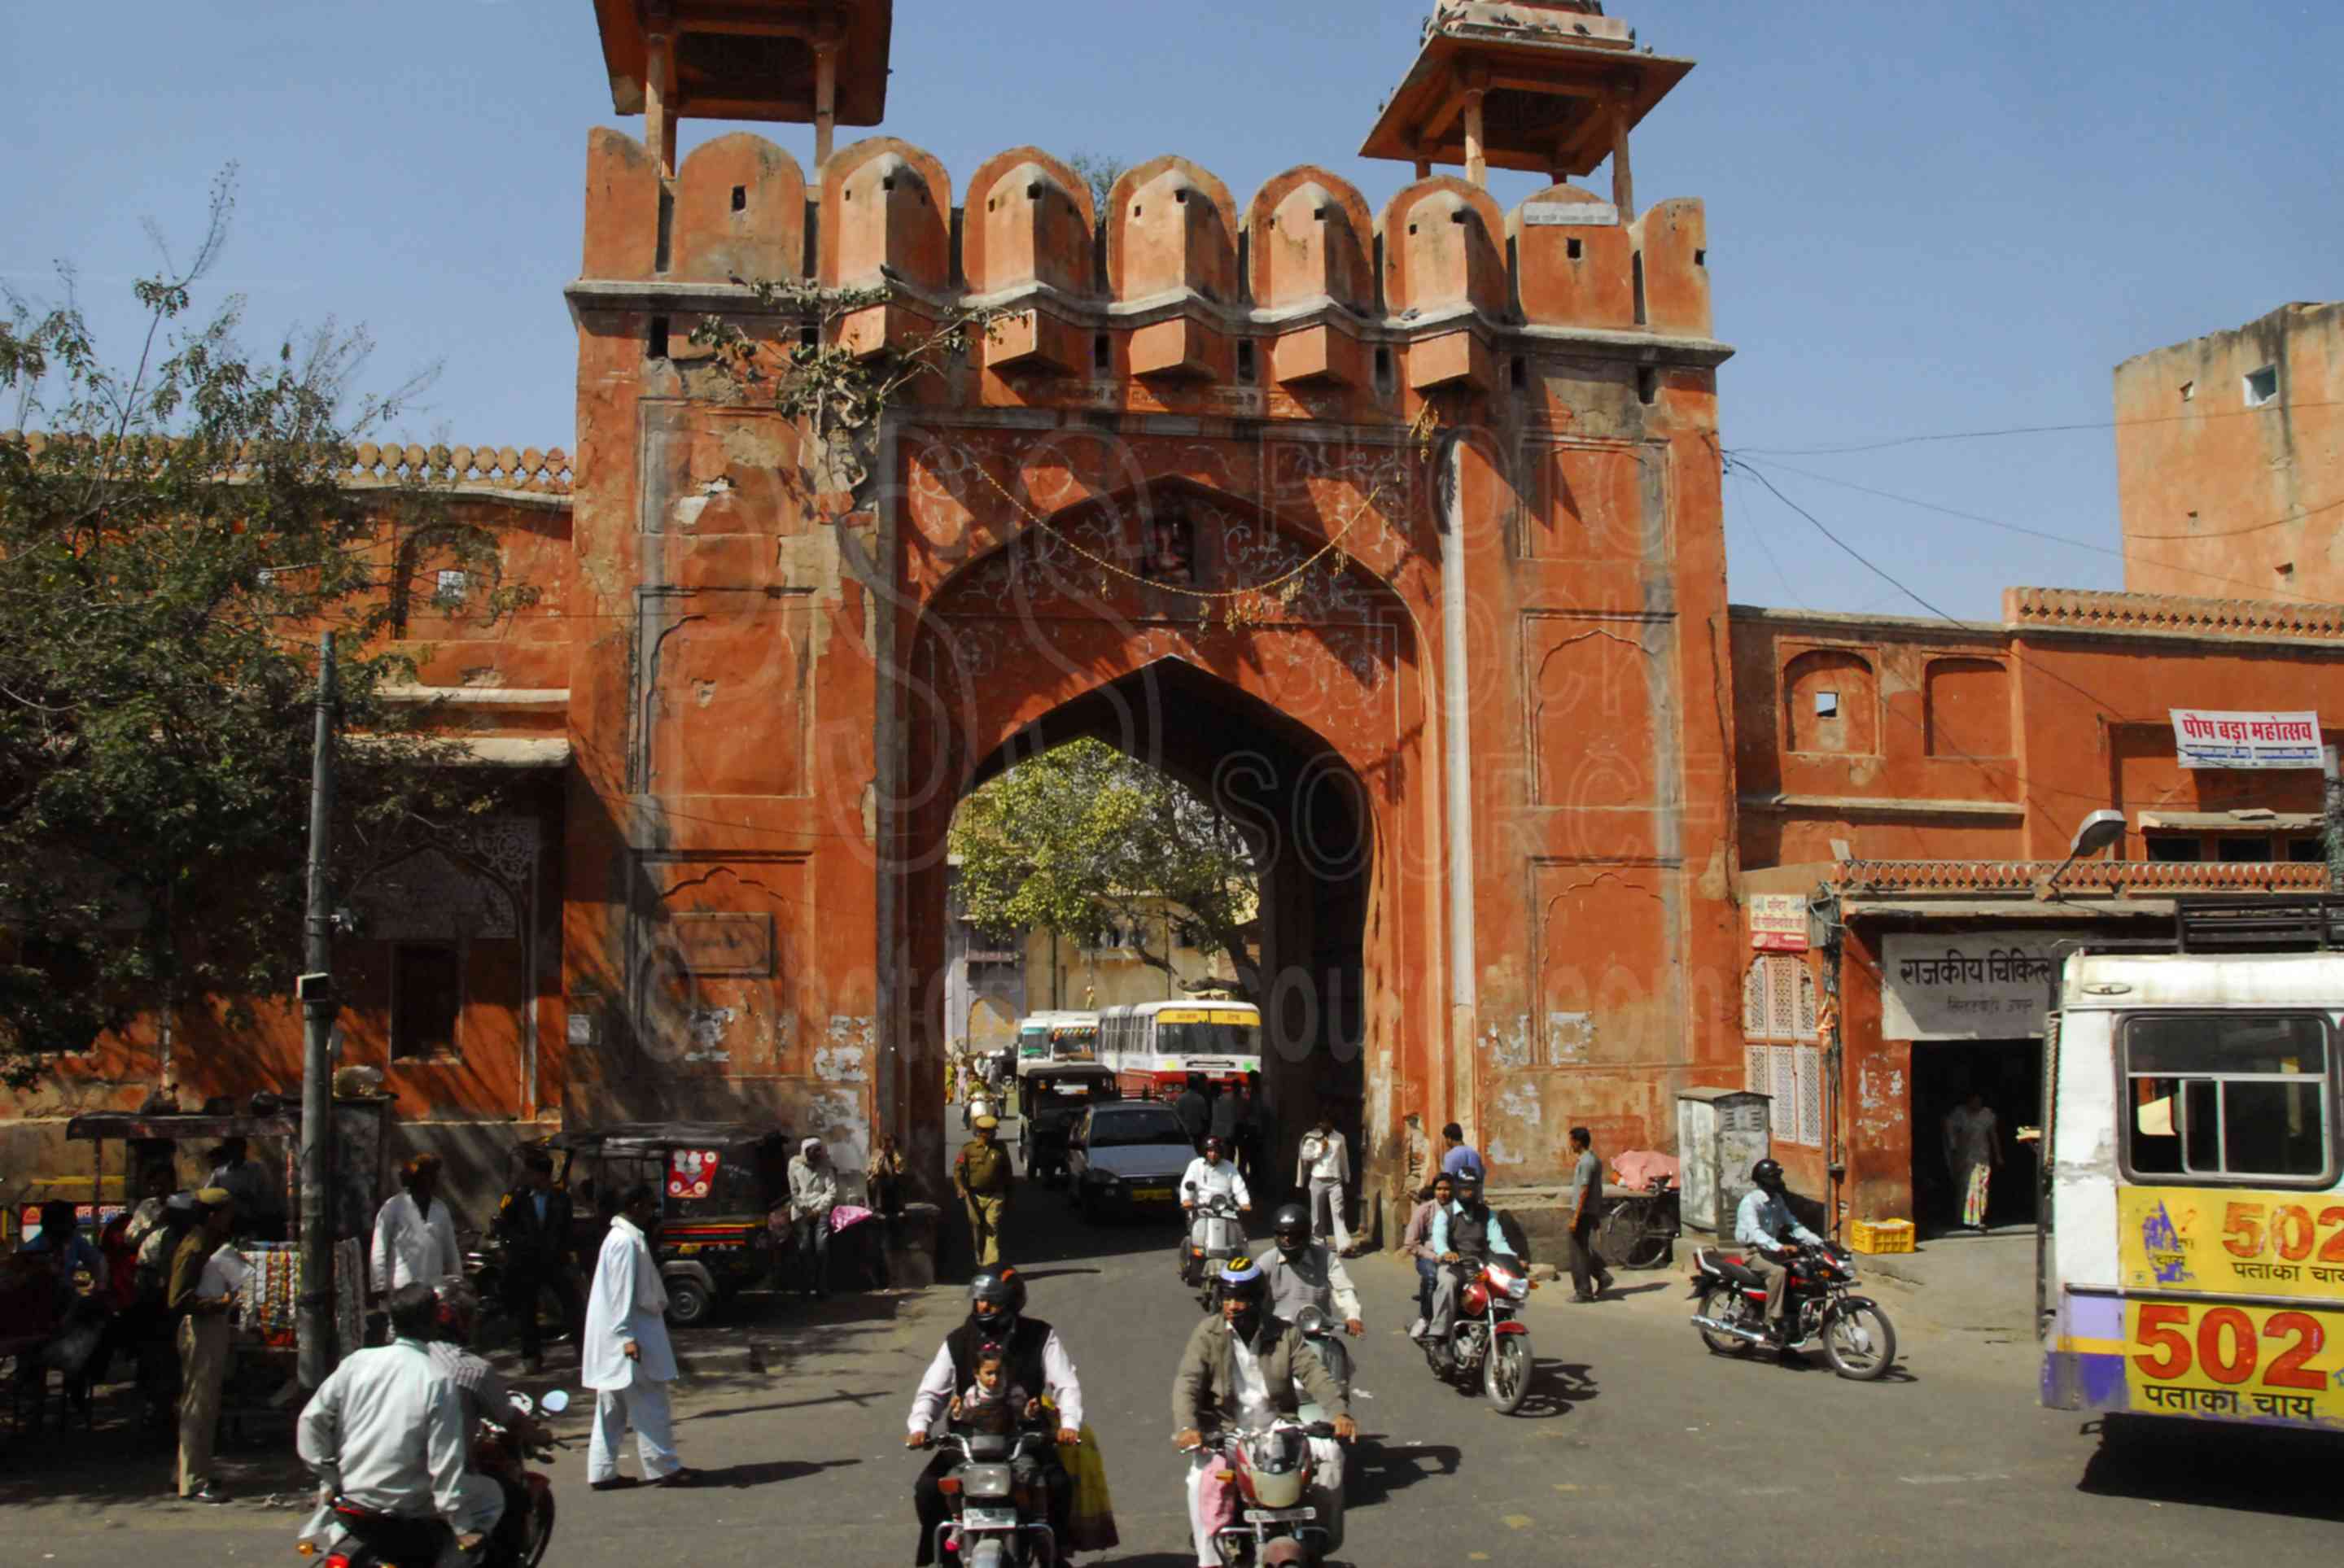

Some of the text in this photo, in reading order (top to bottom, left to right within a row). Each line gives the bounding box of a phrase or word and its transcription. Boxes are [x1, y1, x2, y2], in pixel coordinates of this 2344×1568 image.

[2182, 713, 2215, 740] पौष
[2250, 714, 2313, 742] महोत्सव
[1900, 948, 1983, 985] राजकीय
[2222, 1201, 2344, 1264] 502
[2231, 1262, 2302, 1282] पताका
[2132, 1303, 2328, 1391] 502
[2142, 1385, 2314, 1421] पताका चाय
